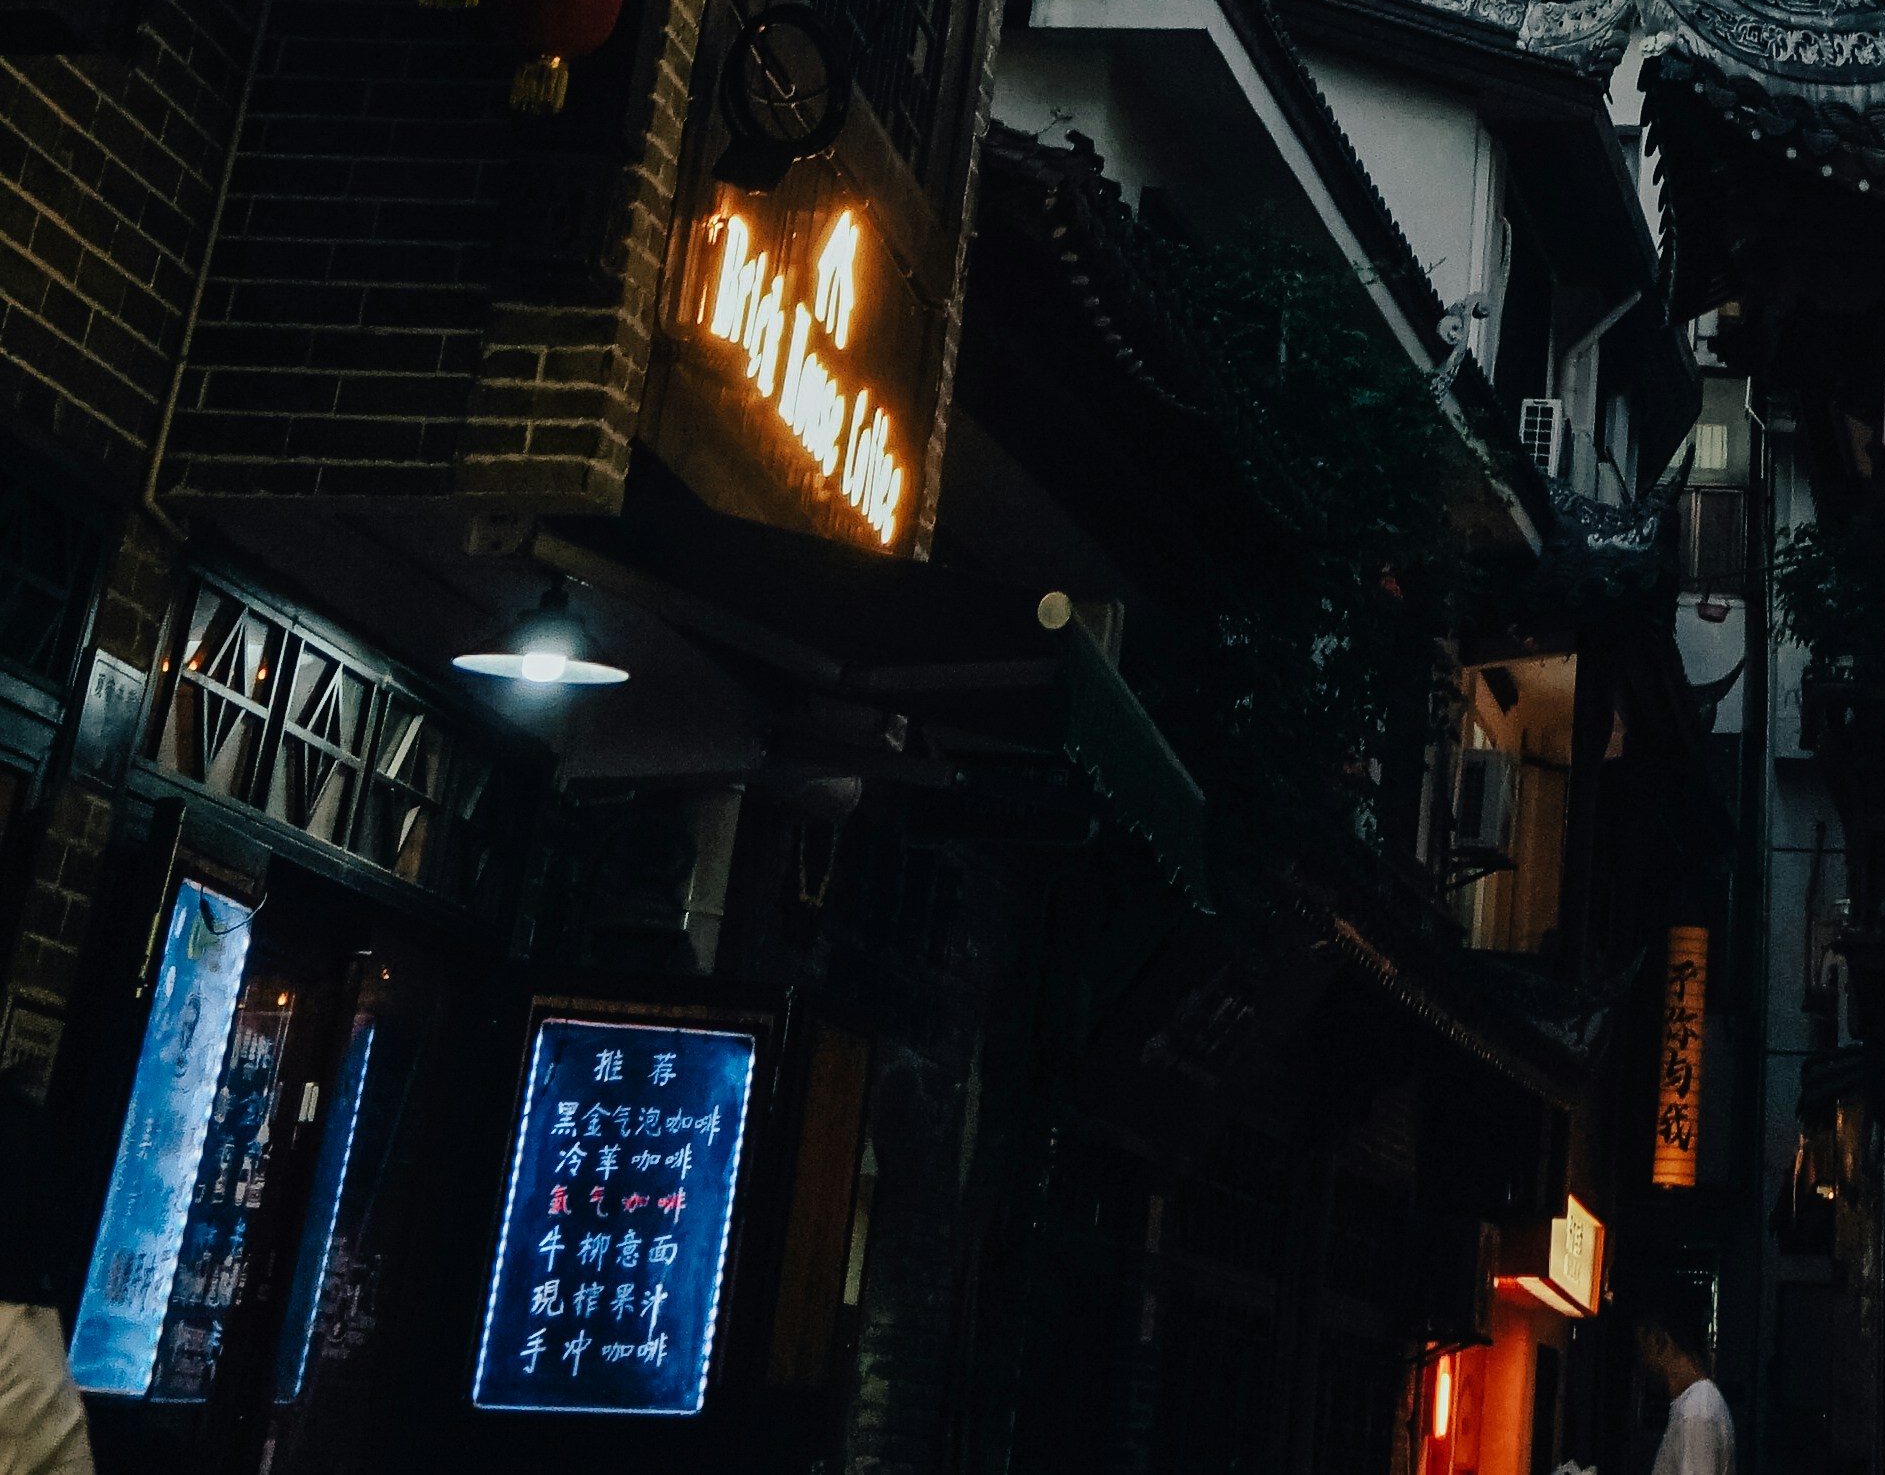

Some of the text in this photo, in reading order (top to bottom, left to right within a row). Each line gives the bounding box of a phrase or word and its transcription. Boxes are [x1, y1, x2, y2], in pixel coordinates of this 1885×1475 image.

[841, 390, 902, 544] Coffee
[593, 1049, 677, 1087] 推荐
[549, 1101, 721, 1146] 黑金气泡咖啡
[554, 1143, 693, 1180] 冷萃咖啡
[538, 1225, 678, 1271] 牛柳意面
[520, 1327, 668, 1376] 手冲咖啡
